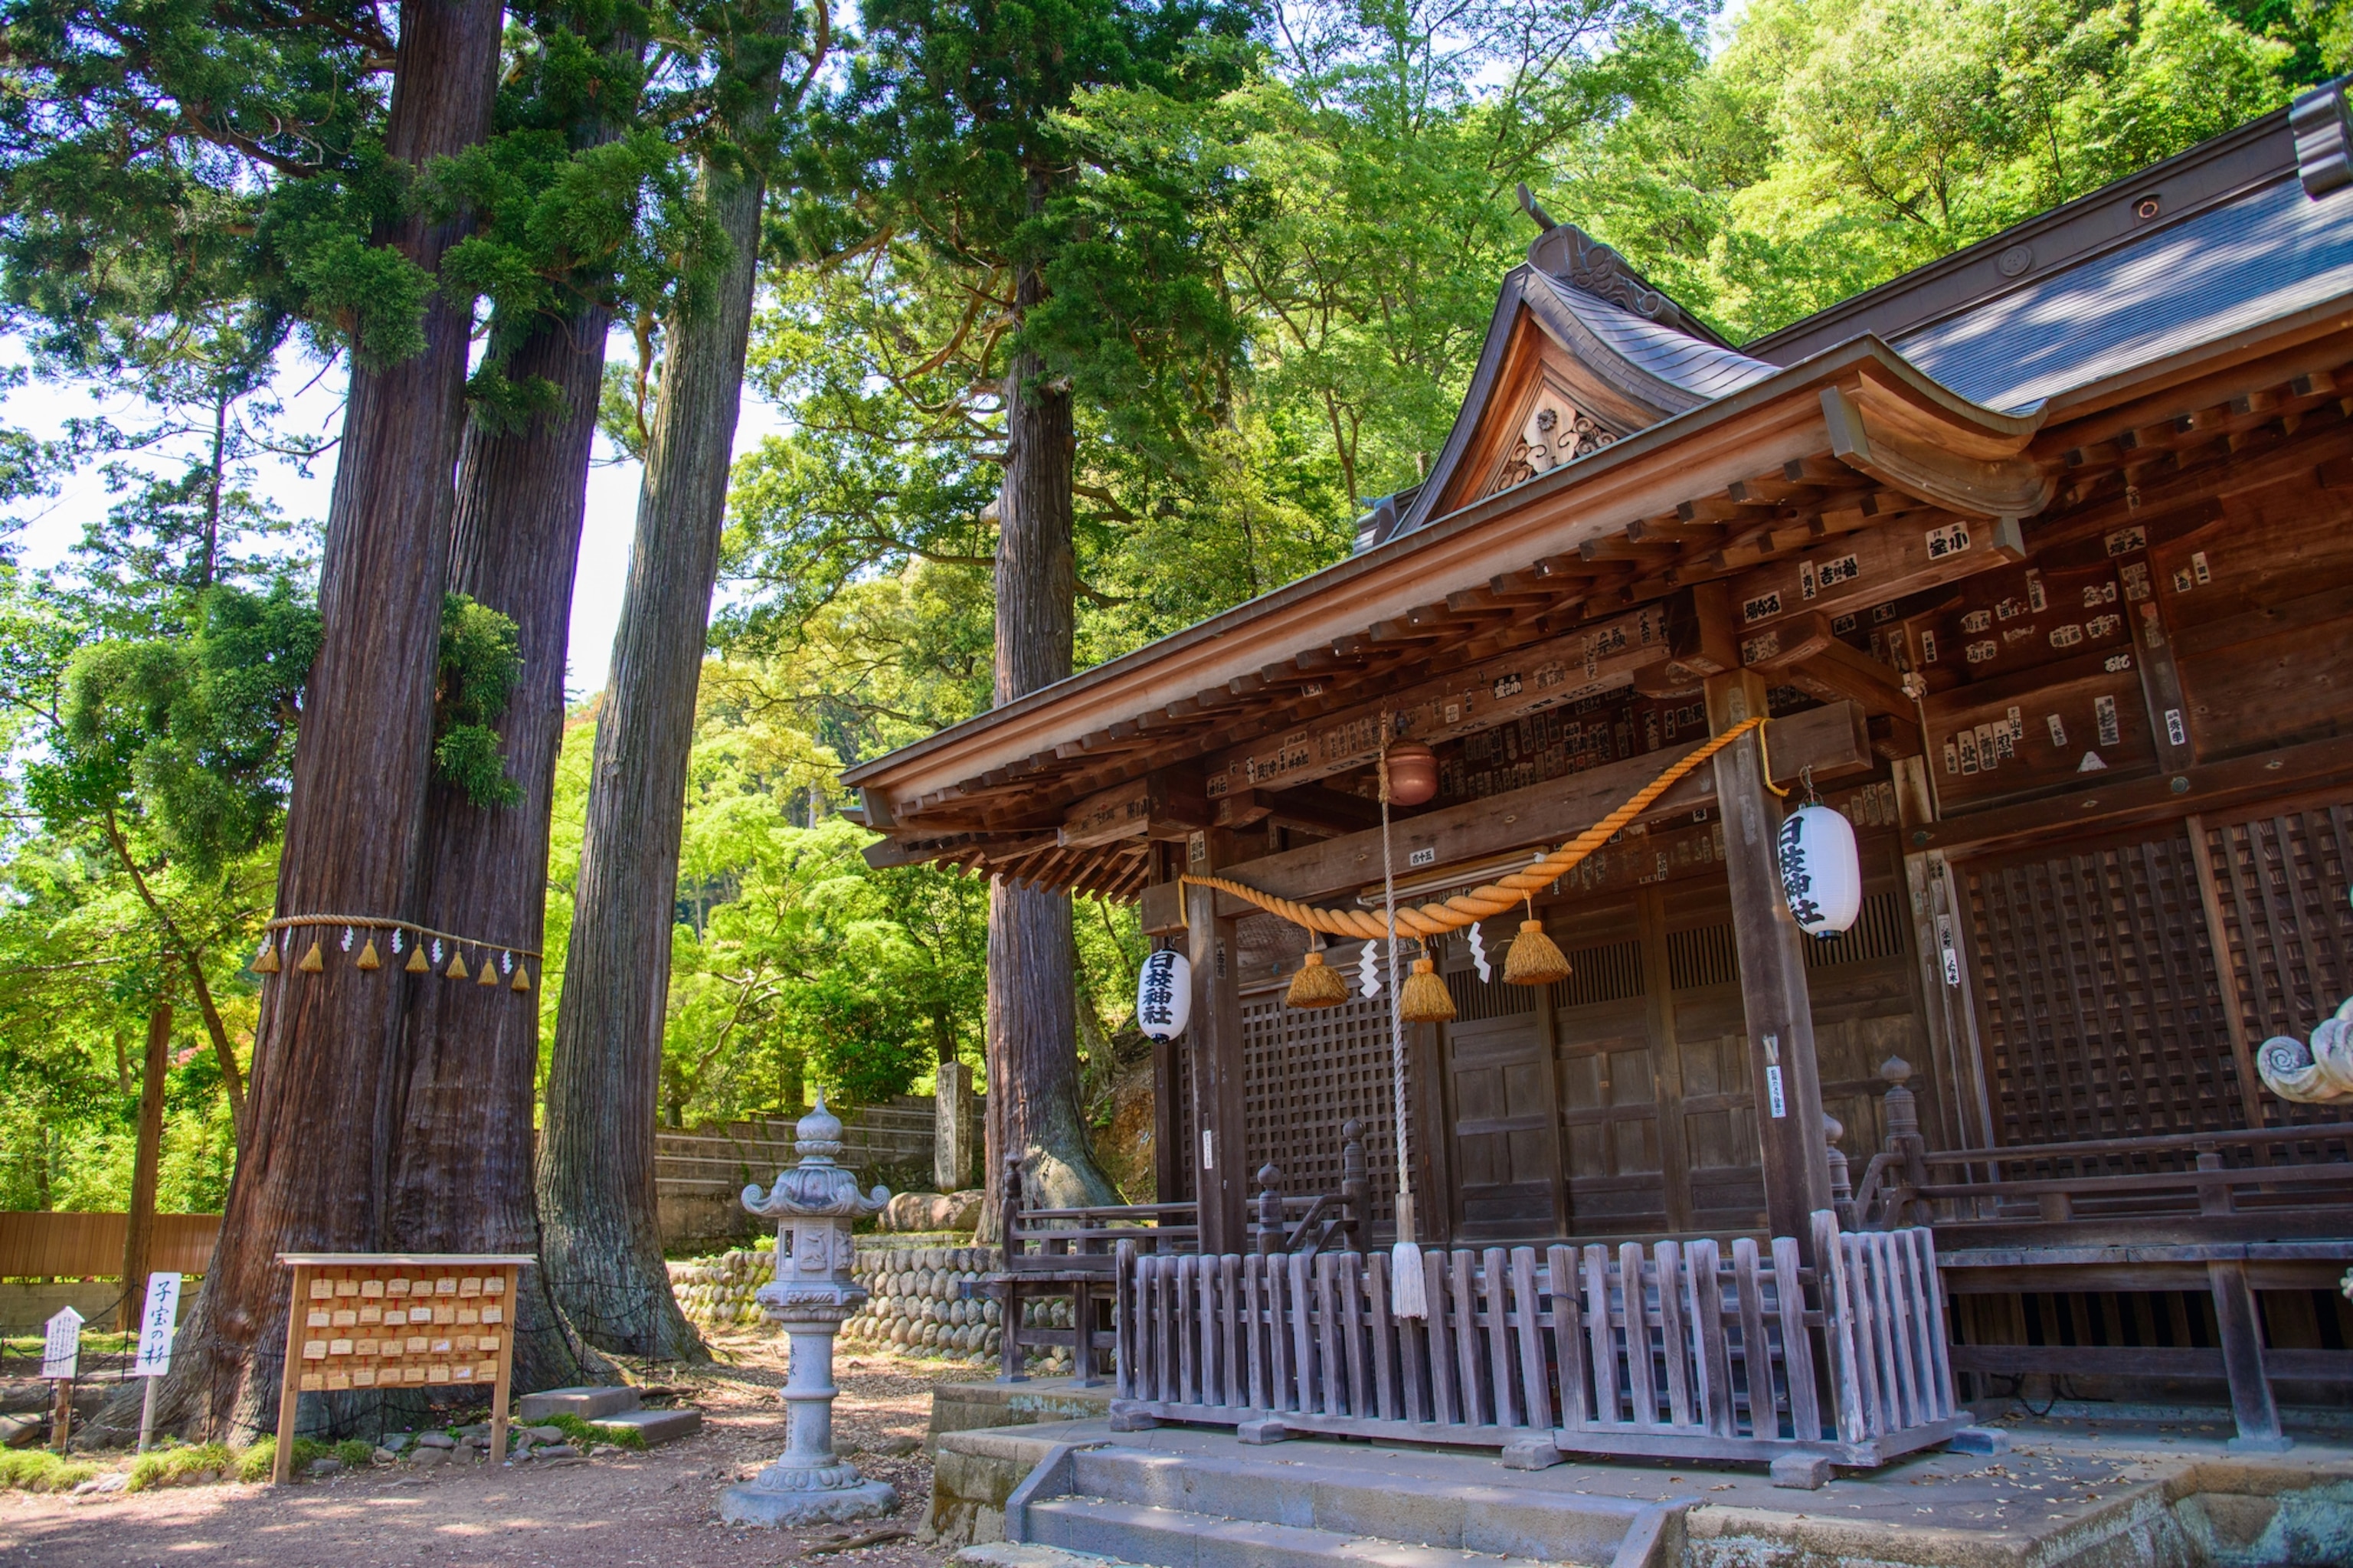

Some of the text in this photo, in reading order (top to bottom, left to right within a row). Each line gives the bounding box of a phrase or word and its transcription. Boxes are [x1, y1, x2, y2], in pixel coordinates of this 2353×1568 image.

[1778, 816, 1825, 926] 日枝神社
[1142, 952, 1176, 1025] 日枝神社
[143, 1281, 172, 1367] 子宝の杉
